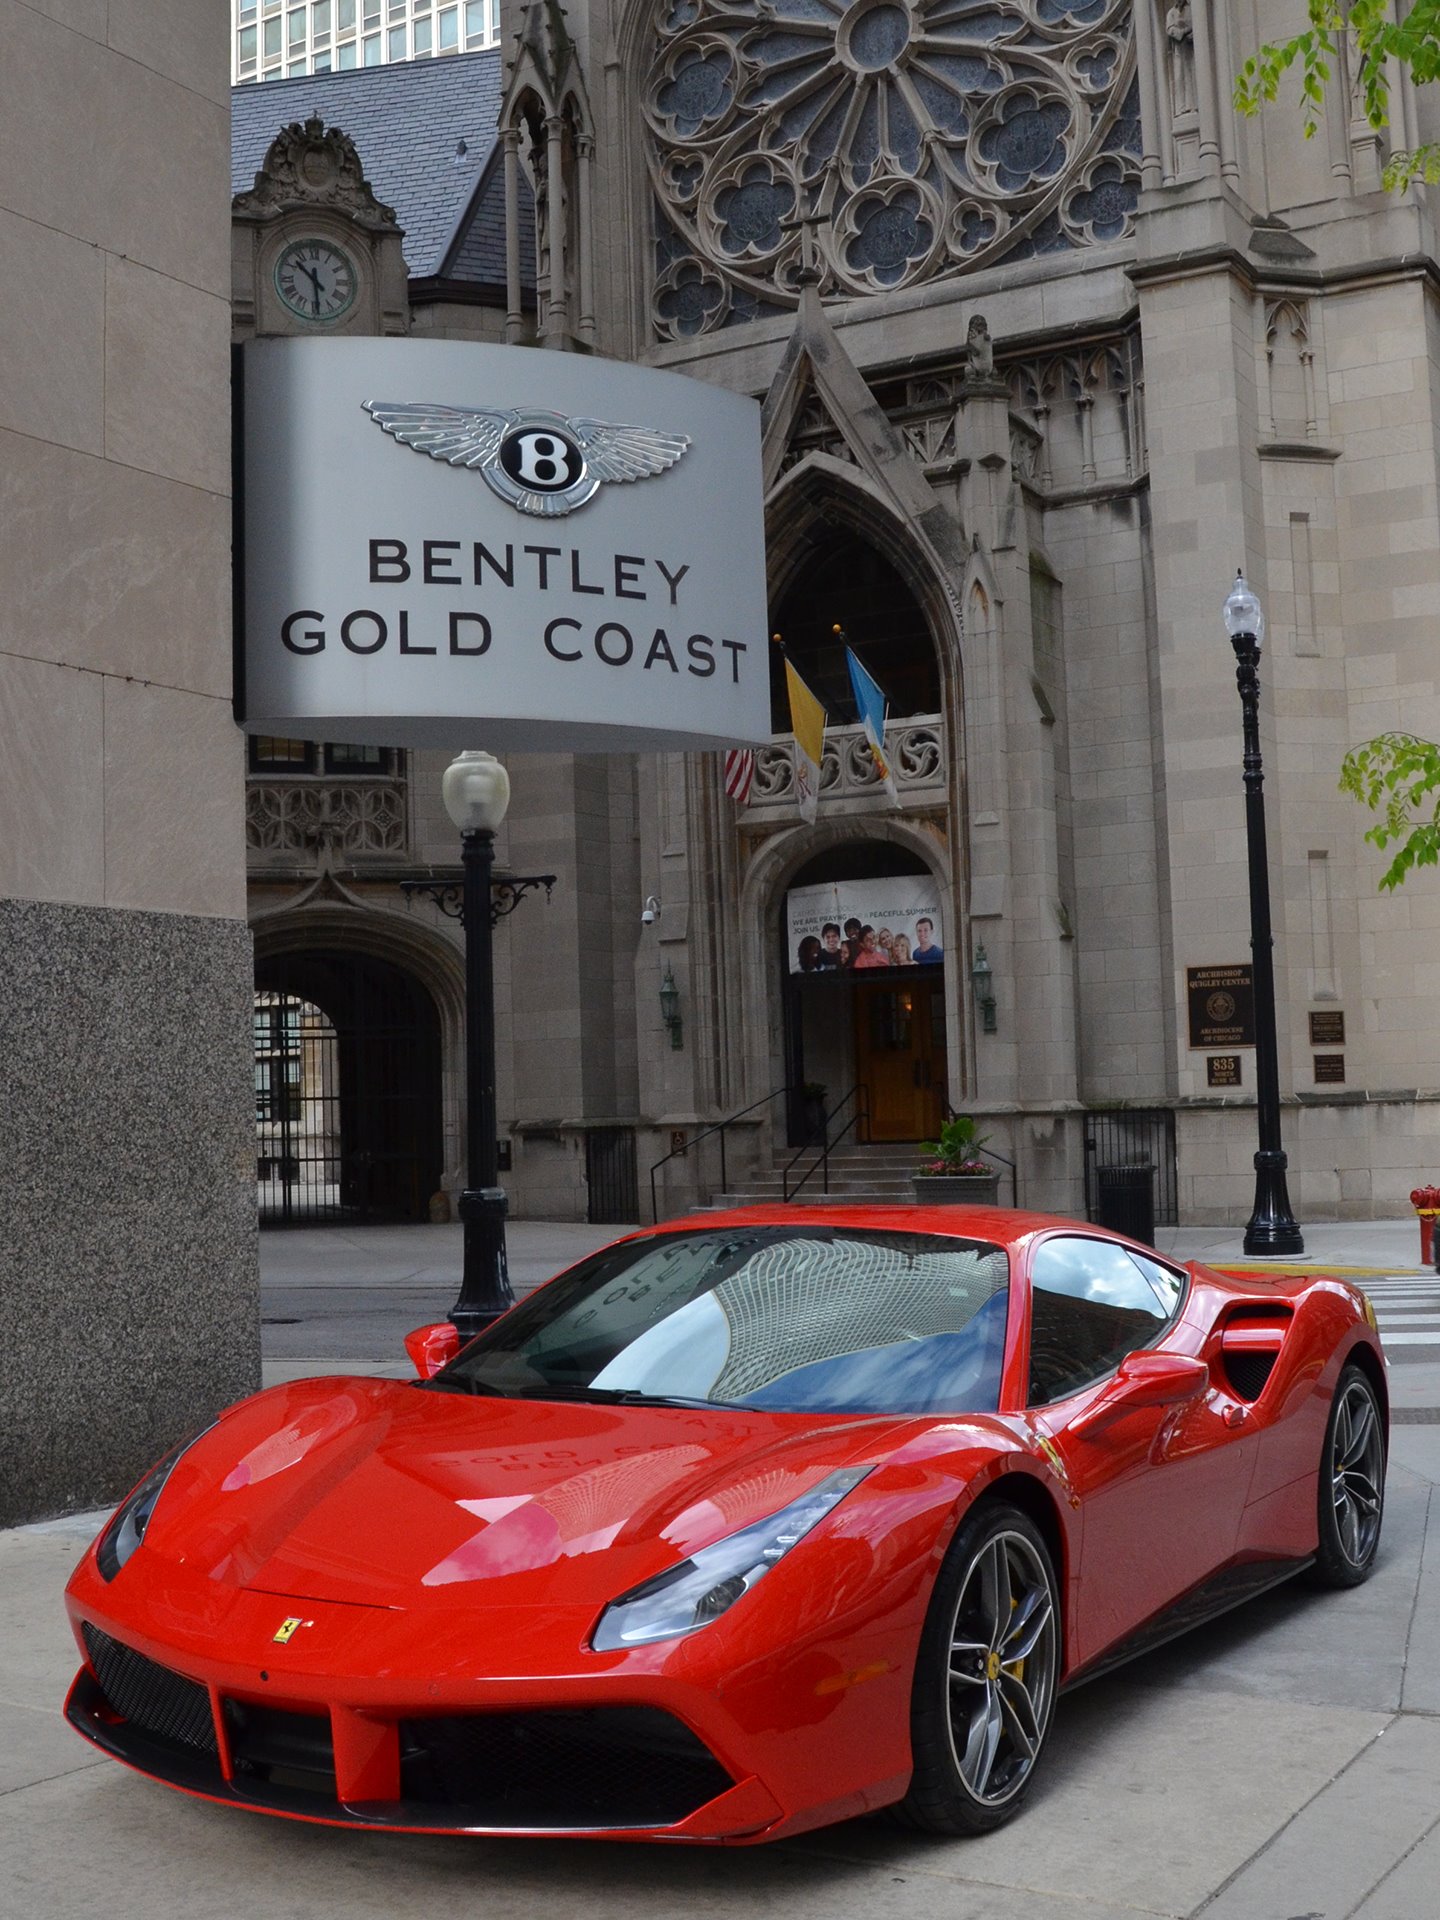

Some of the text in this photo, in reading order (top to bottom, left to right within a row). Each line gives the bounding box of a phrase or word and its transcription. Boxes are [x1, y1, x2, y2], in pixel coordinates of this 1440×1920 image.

[517, 432, 571, 486] B
[368, 538, 691, 606] BENTLEY
[280, 609, 748, 683] GOLD COAST
[869, 910, 905, 918] PEACEFUL
[1196, 969, 1243, 979] ARCHBISHOP
[1221, 978, 1251, 986] CENTER
[1213, 1058, 1235, 1070] 835
